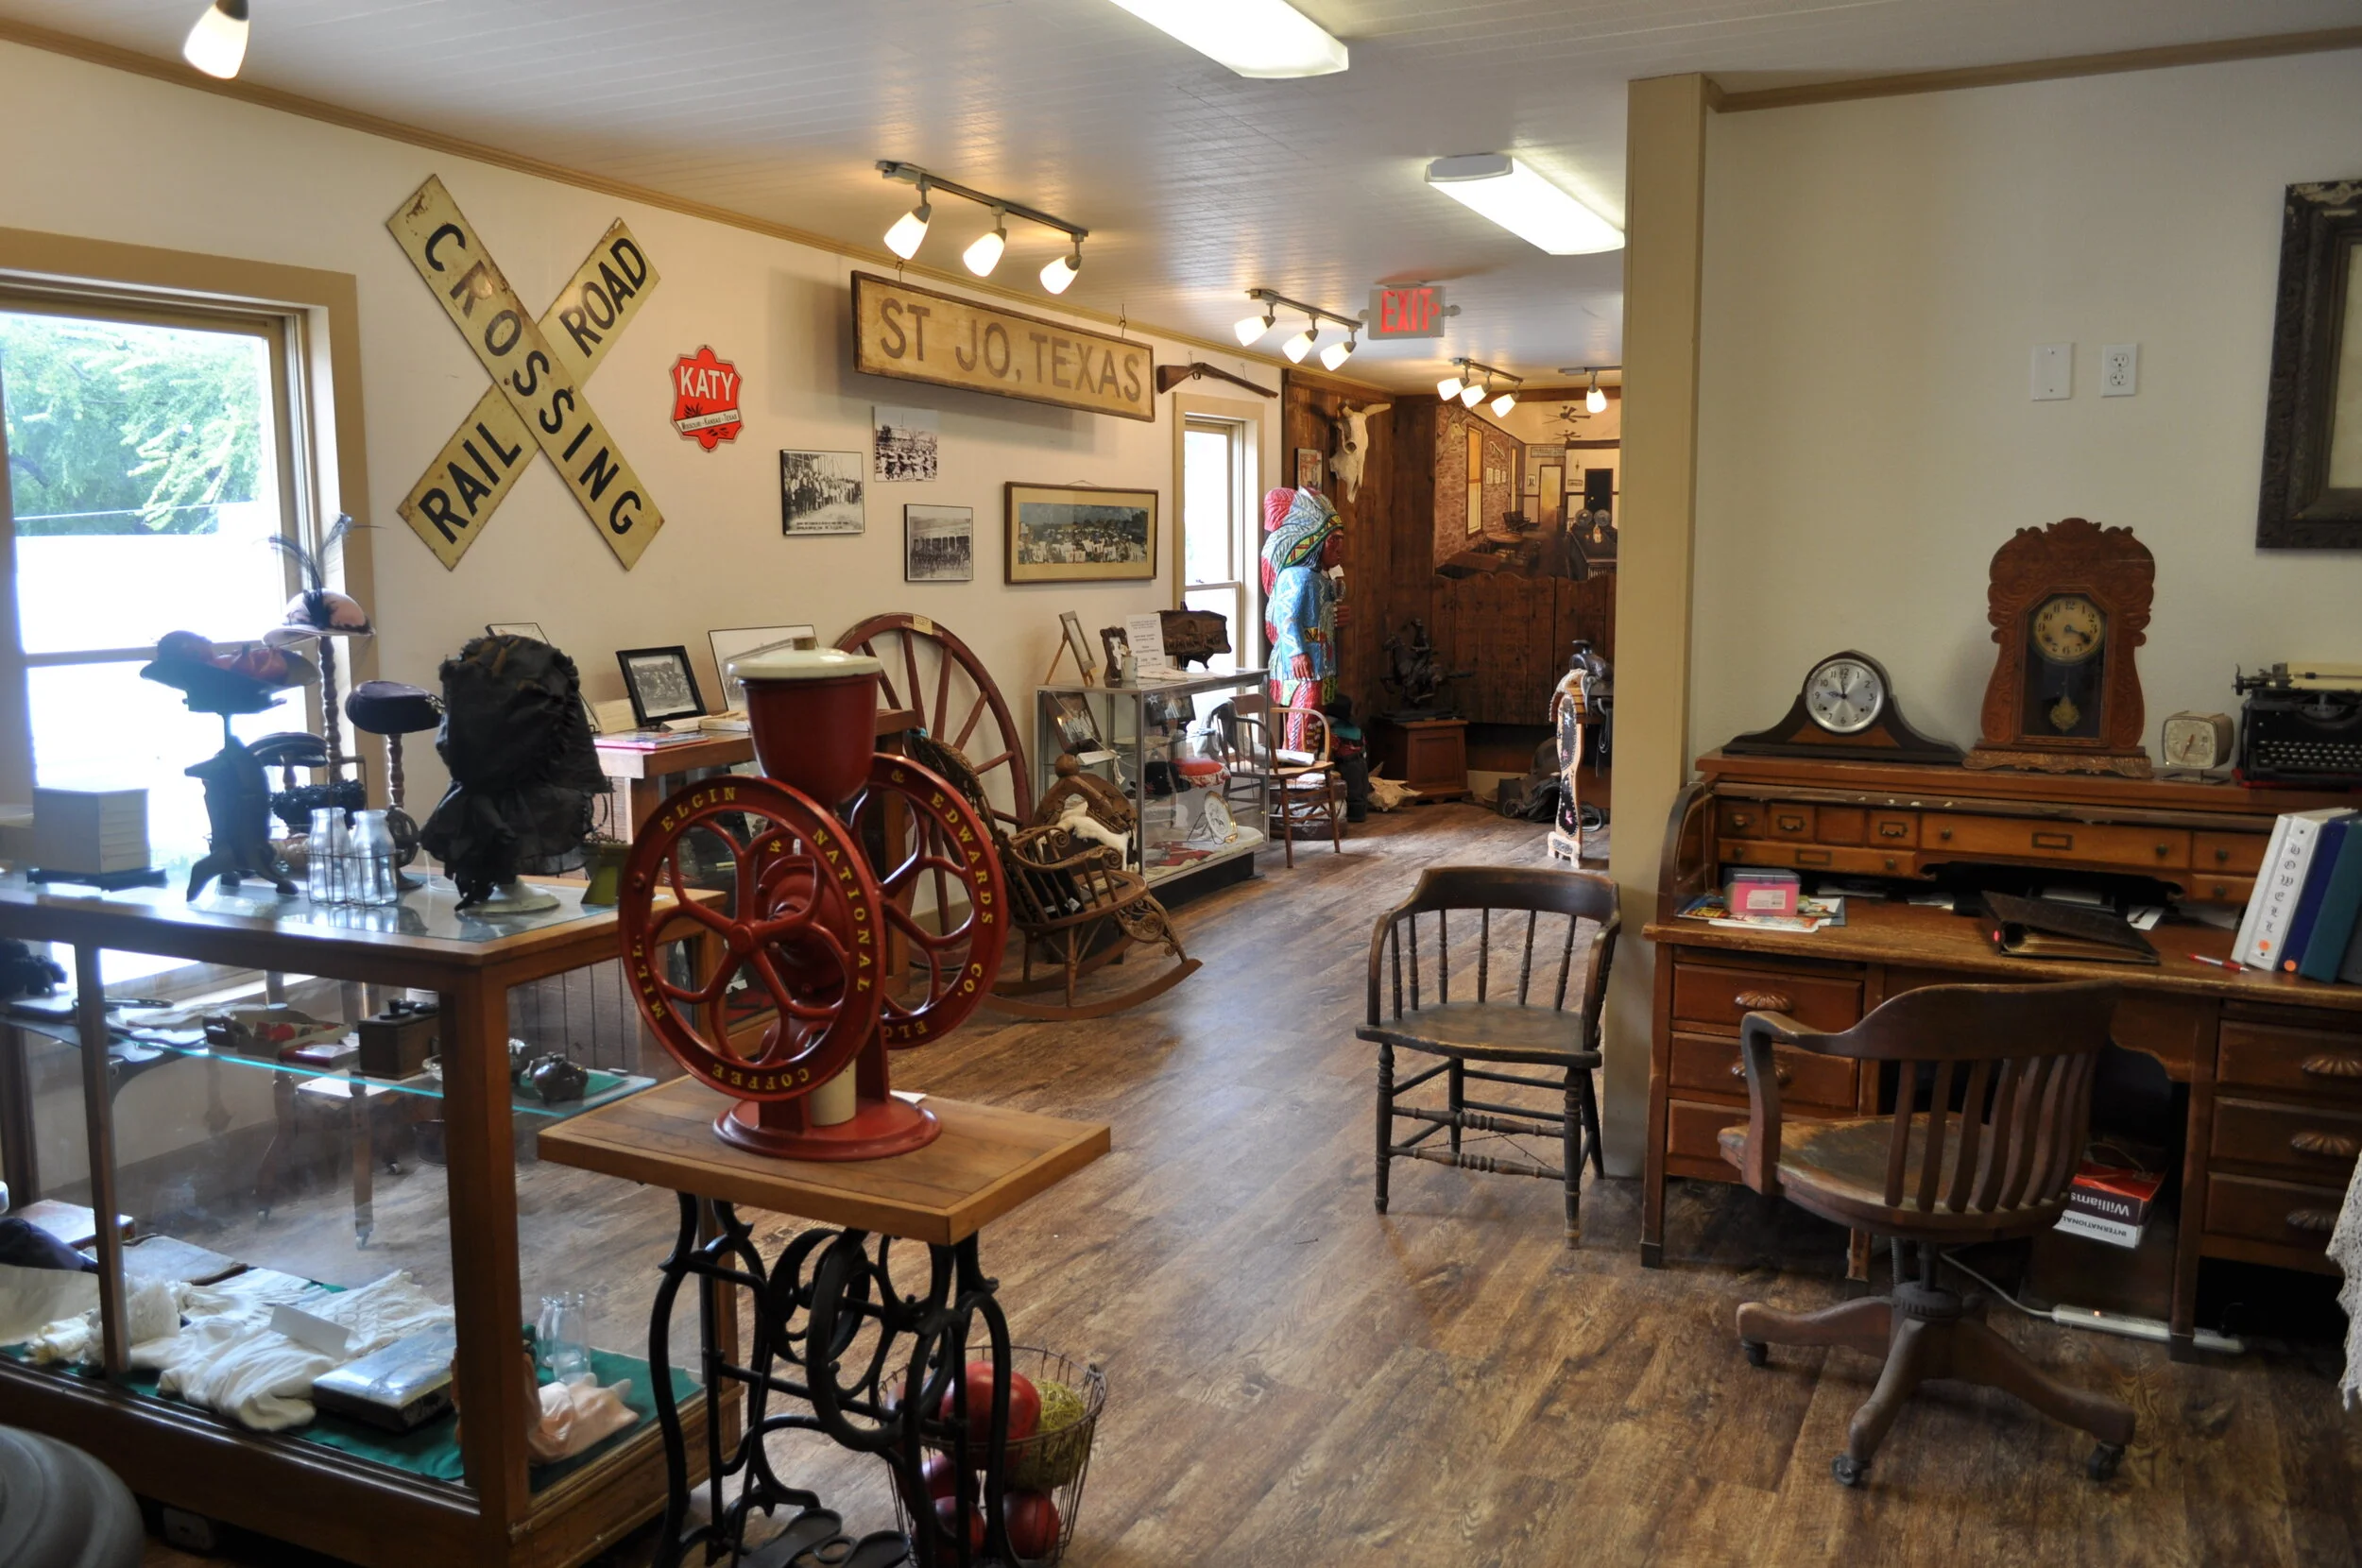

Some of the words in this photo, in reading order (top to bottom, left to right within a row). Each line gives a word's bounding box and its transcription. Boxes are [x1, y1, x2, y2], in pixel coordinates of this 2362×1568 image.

[558, 237, 648, 358] ROAD
[1380, 288, 1433, 332] EXIT
[425, 223, 642, 535] CROSSING
[680, 366, 734, 401] KATY
[880, 298, 931, 361] ST
[1029, 332, 1141, 402] TEXAS
[419, 422, 522, 545] RAIL
[661, 787, 735, 831] ELGIN
[813, 828, 872, 992] NATIONAL
[930, 792, 993, 925] EDWARDS
[632, 945, 665, 1020] MILL
[712, 1064, 810, 1090] COFFEE
[2062, 1216, 2127, 1236] INTERNATIONAL
[2070, 1192, 2130, 1217] Williams
